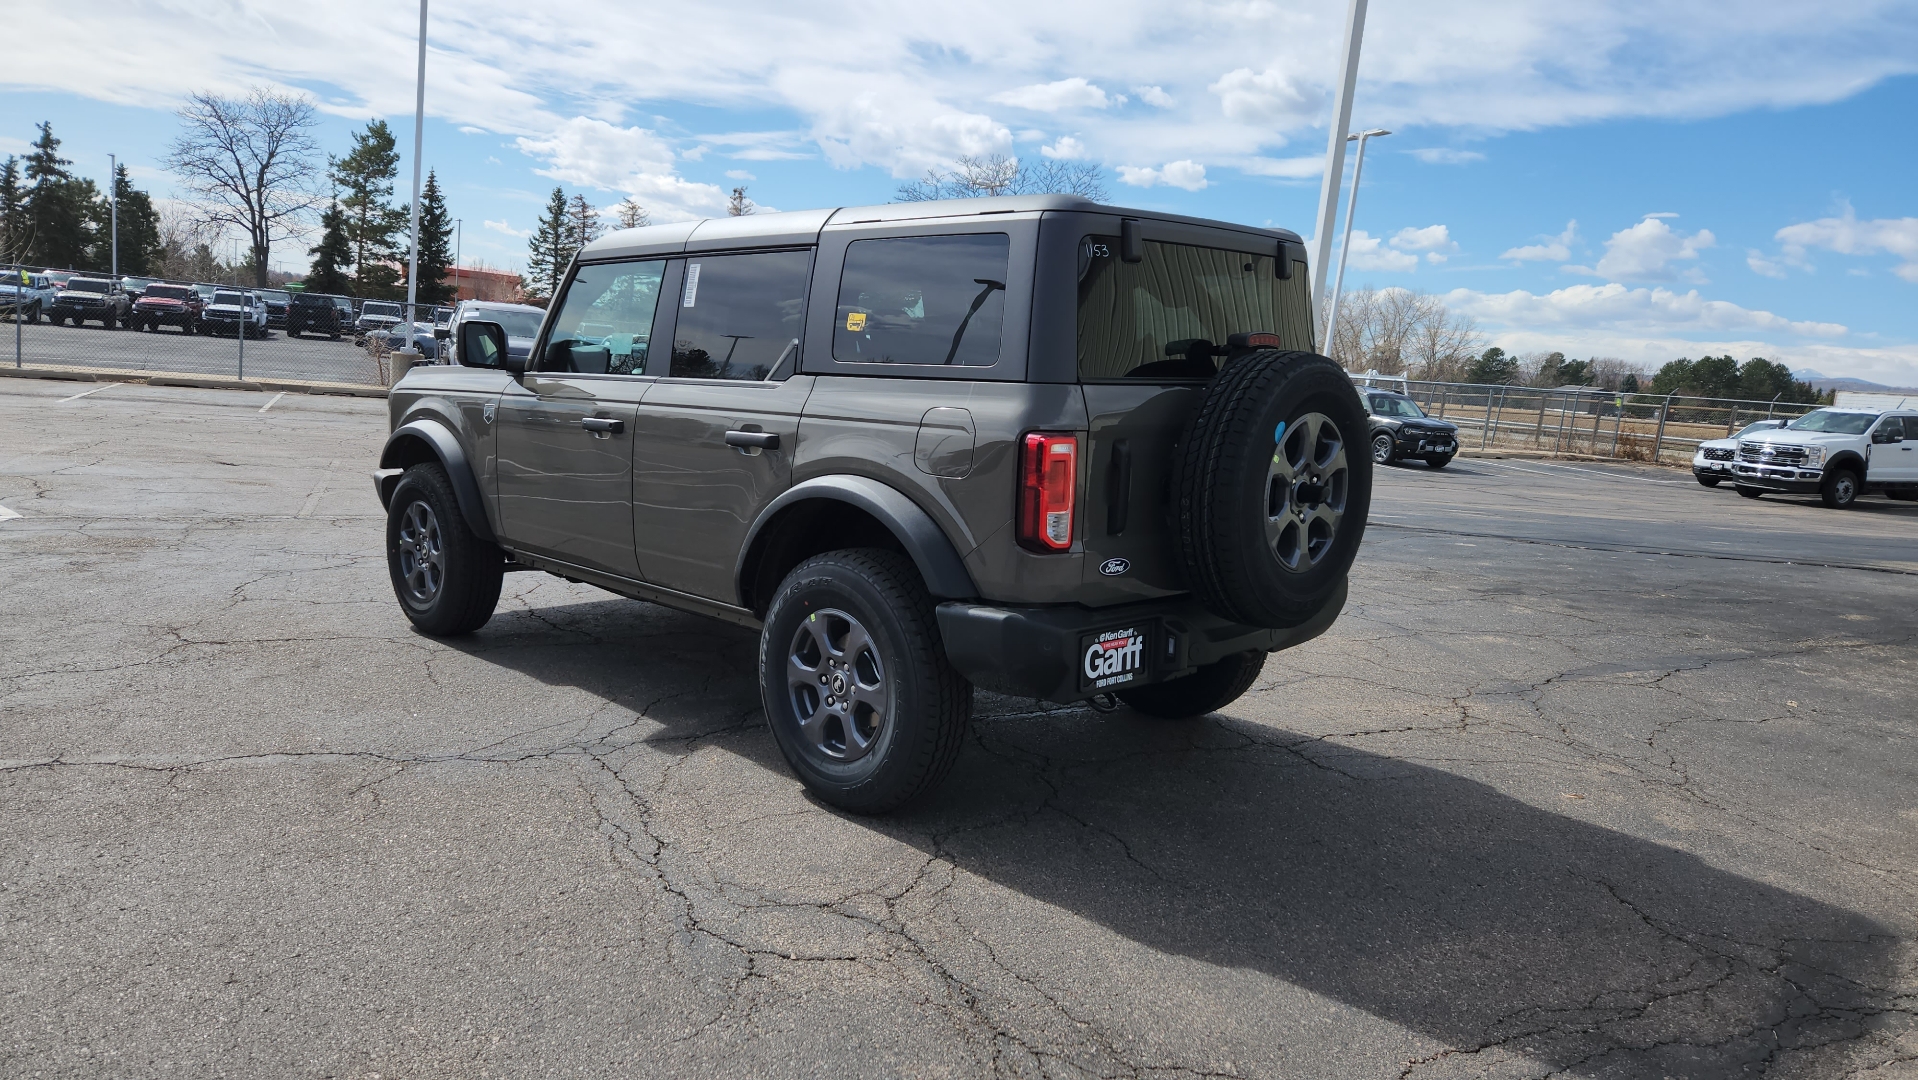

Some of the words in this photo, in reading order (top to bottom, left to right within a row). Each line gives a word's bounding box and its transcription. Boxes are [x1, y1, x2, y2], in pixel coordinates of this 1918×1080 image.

[1085, 243, 1110, 258] 1153
[1105, 560, 1126, 573] Ford
[1105, 632, 1118, 641] Ken
[1118, 628, 1133, 638] Garff
[1084, 635, 1143, 679] Garff
